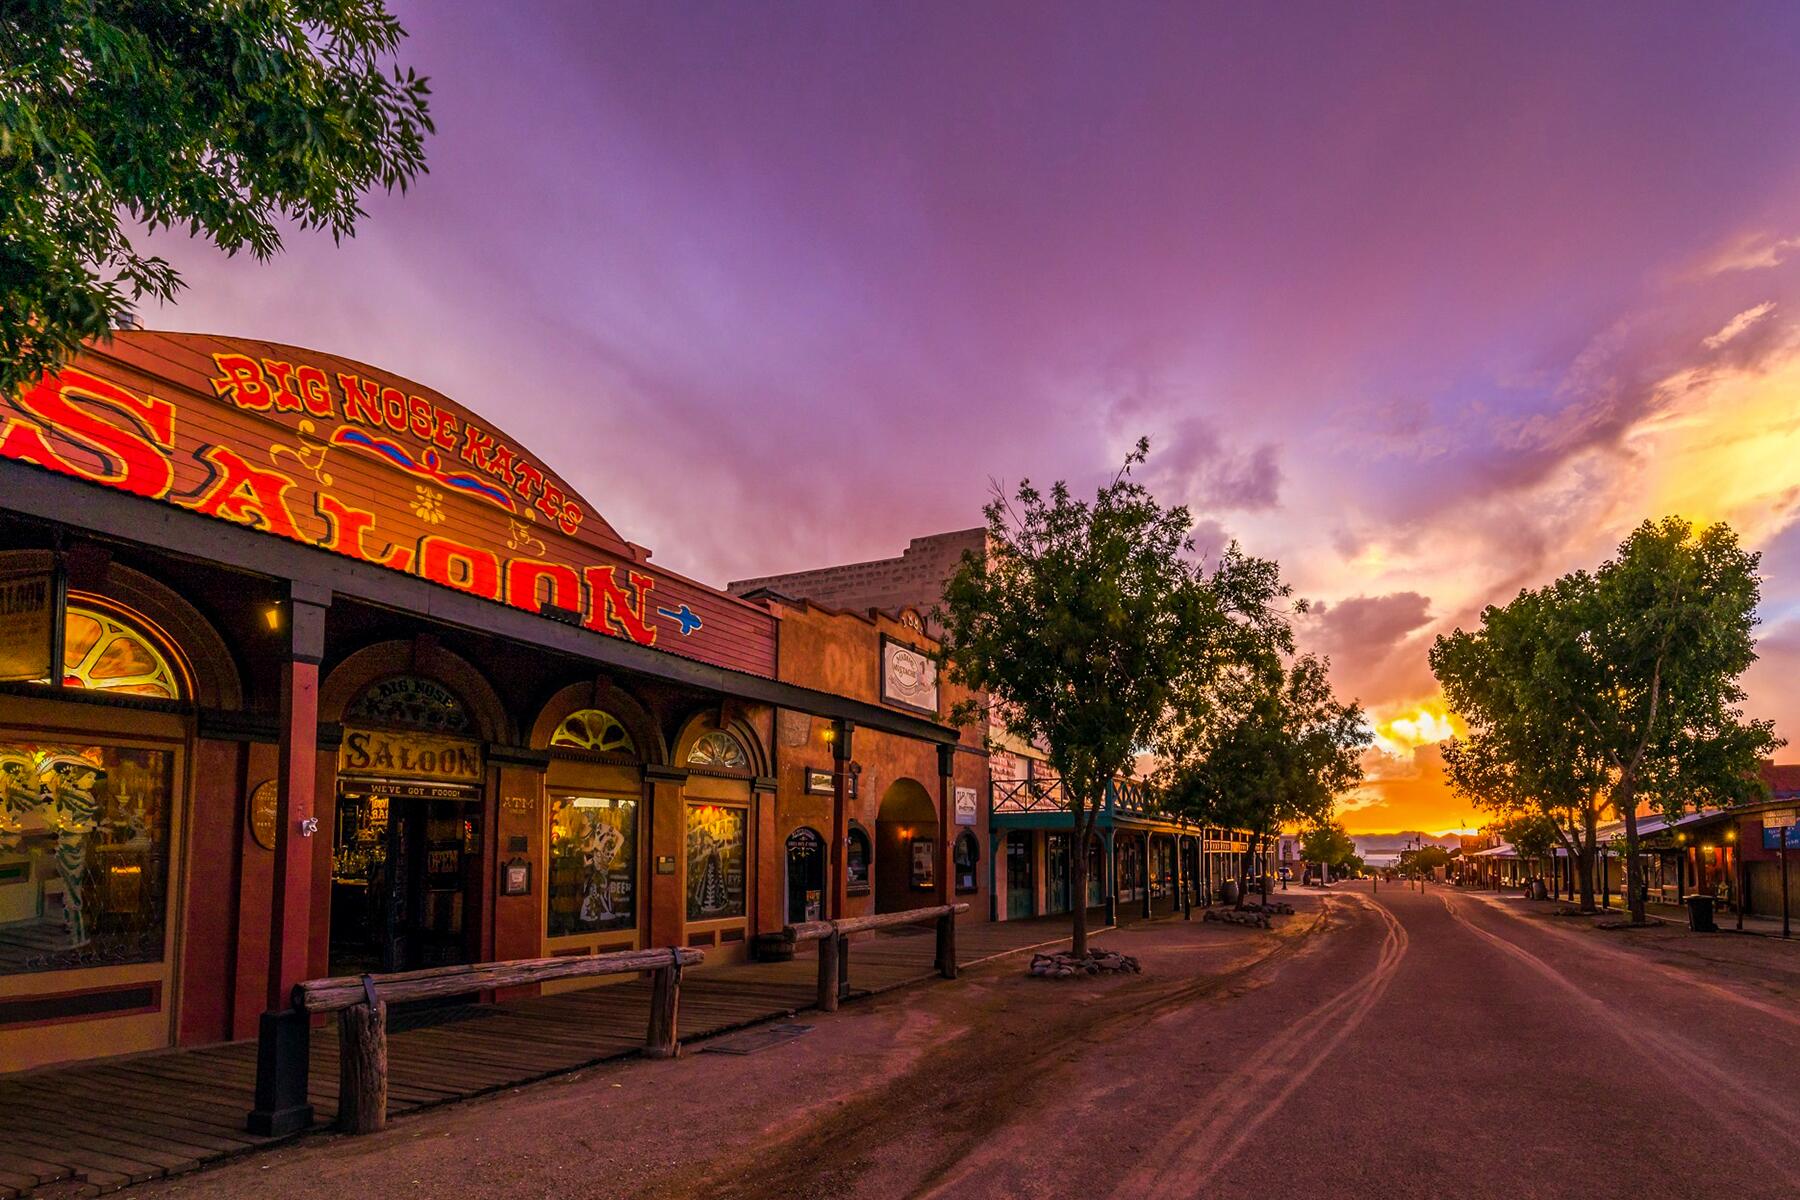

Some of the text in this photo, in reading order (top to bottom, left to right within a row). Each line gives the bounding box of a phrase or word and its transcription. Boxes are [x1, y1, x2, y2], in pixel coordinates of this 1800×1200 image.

[210, 353, 585, 536] BIG NOSE KATES
[0, 365, 657, 647] SALOON
[378, 680, 408, 698] BIG
[346, 732, 478, 776] SALOON
[371, 785, 401, 794] WE'VE
[408, 787, 424, 795] GOT
[503, 797, 535, 808] ATM
